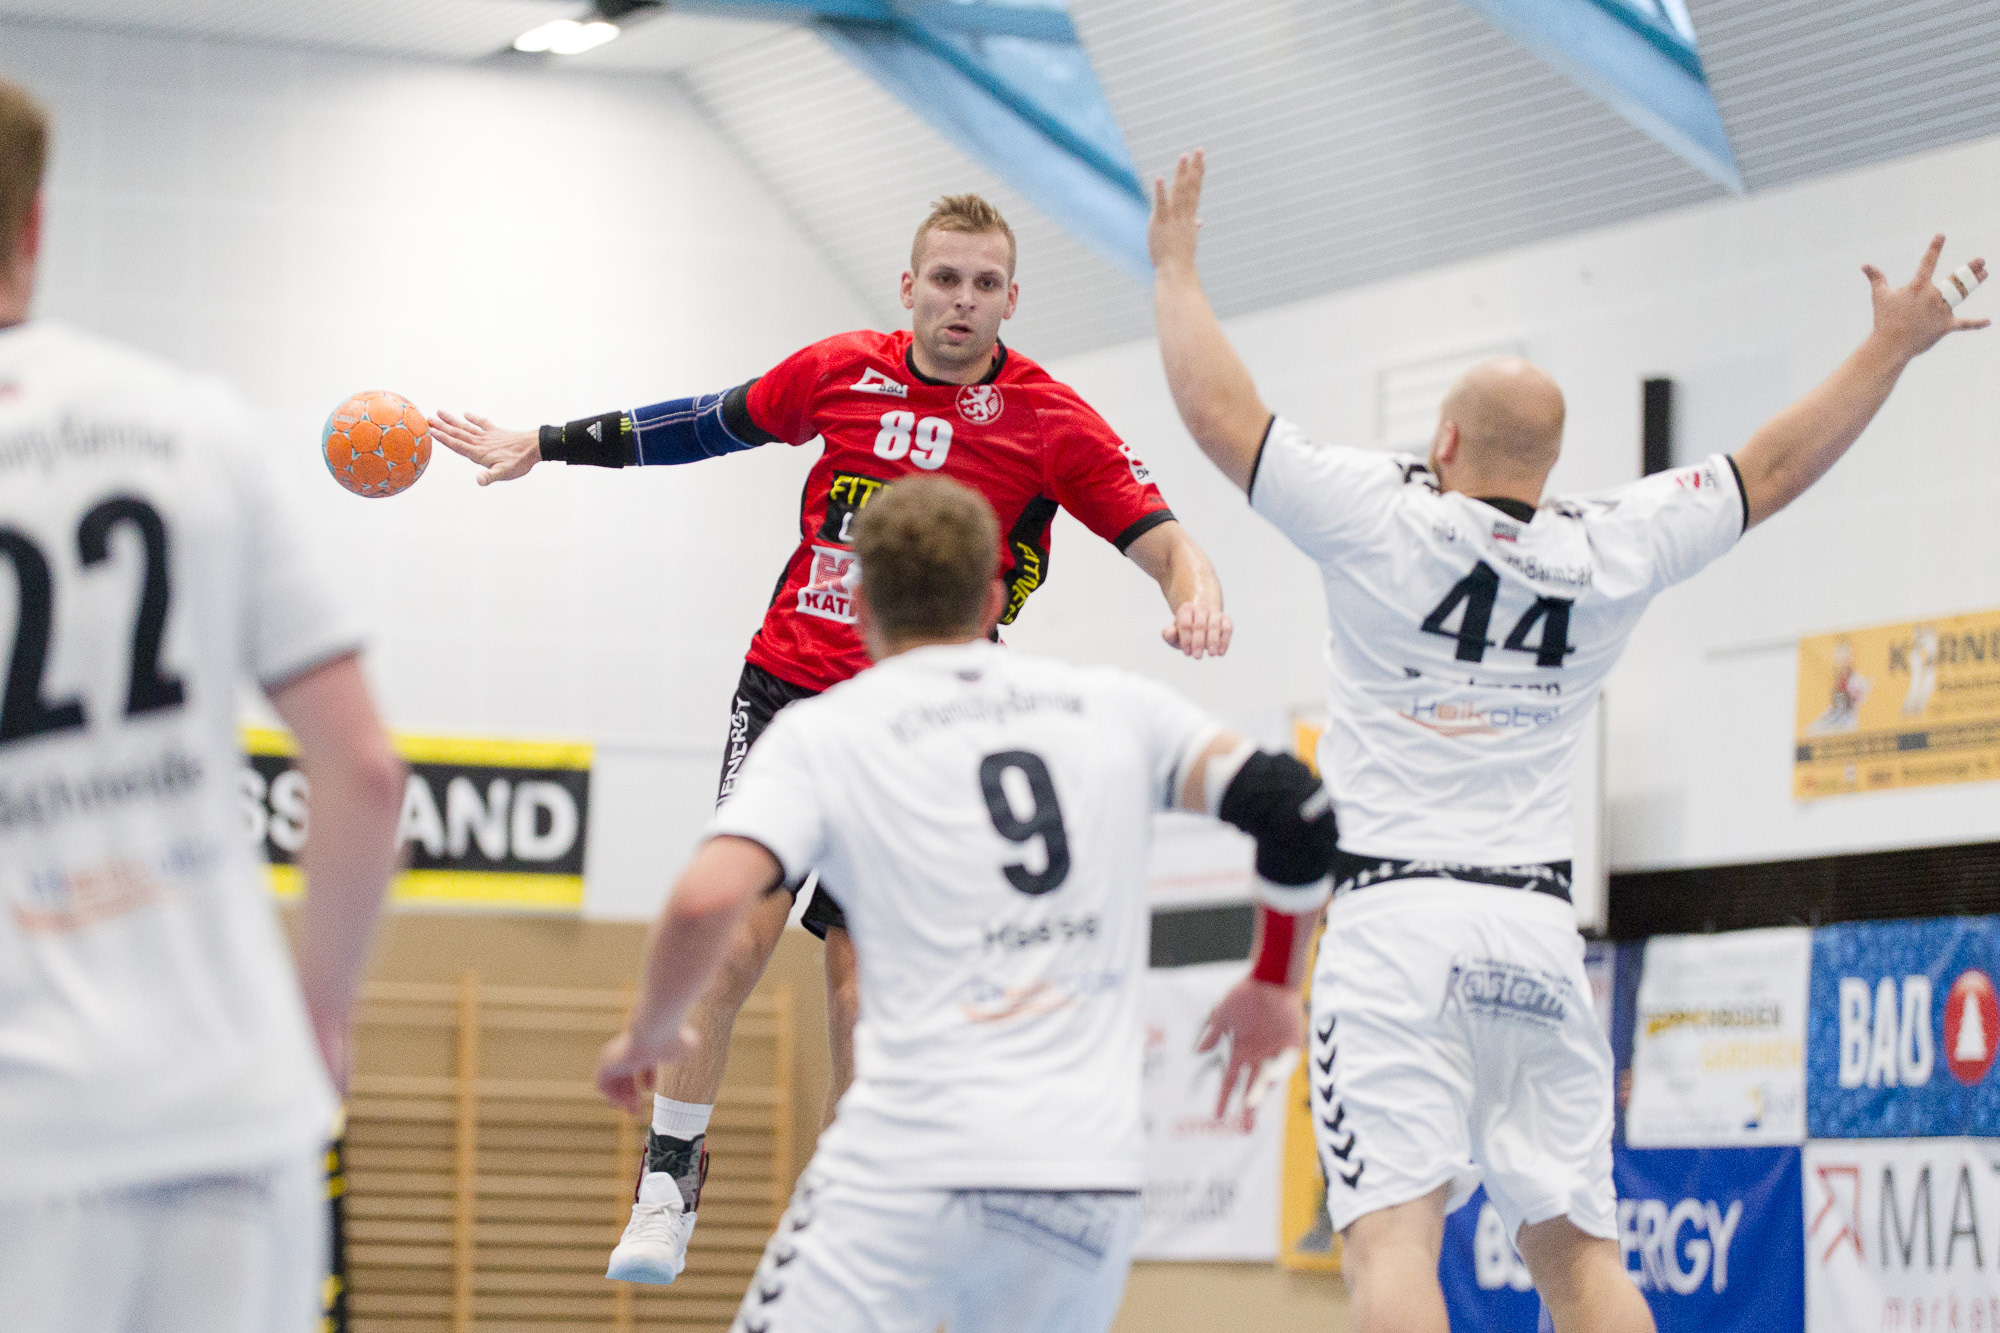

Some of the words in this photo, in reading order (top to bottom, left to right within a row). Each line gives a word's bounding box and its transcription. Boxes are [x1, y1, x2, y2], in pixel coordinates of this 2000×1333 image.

[873, 409, 954, 470] 89
[0, 487, 189, 746] 22
[1419, 559, 1577, 668] 44
[978, 749, 1072, 895] 9
[1839, 975, 1936, 1090] BAU
[1878, 1164, 2000, 1272] MA
